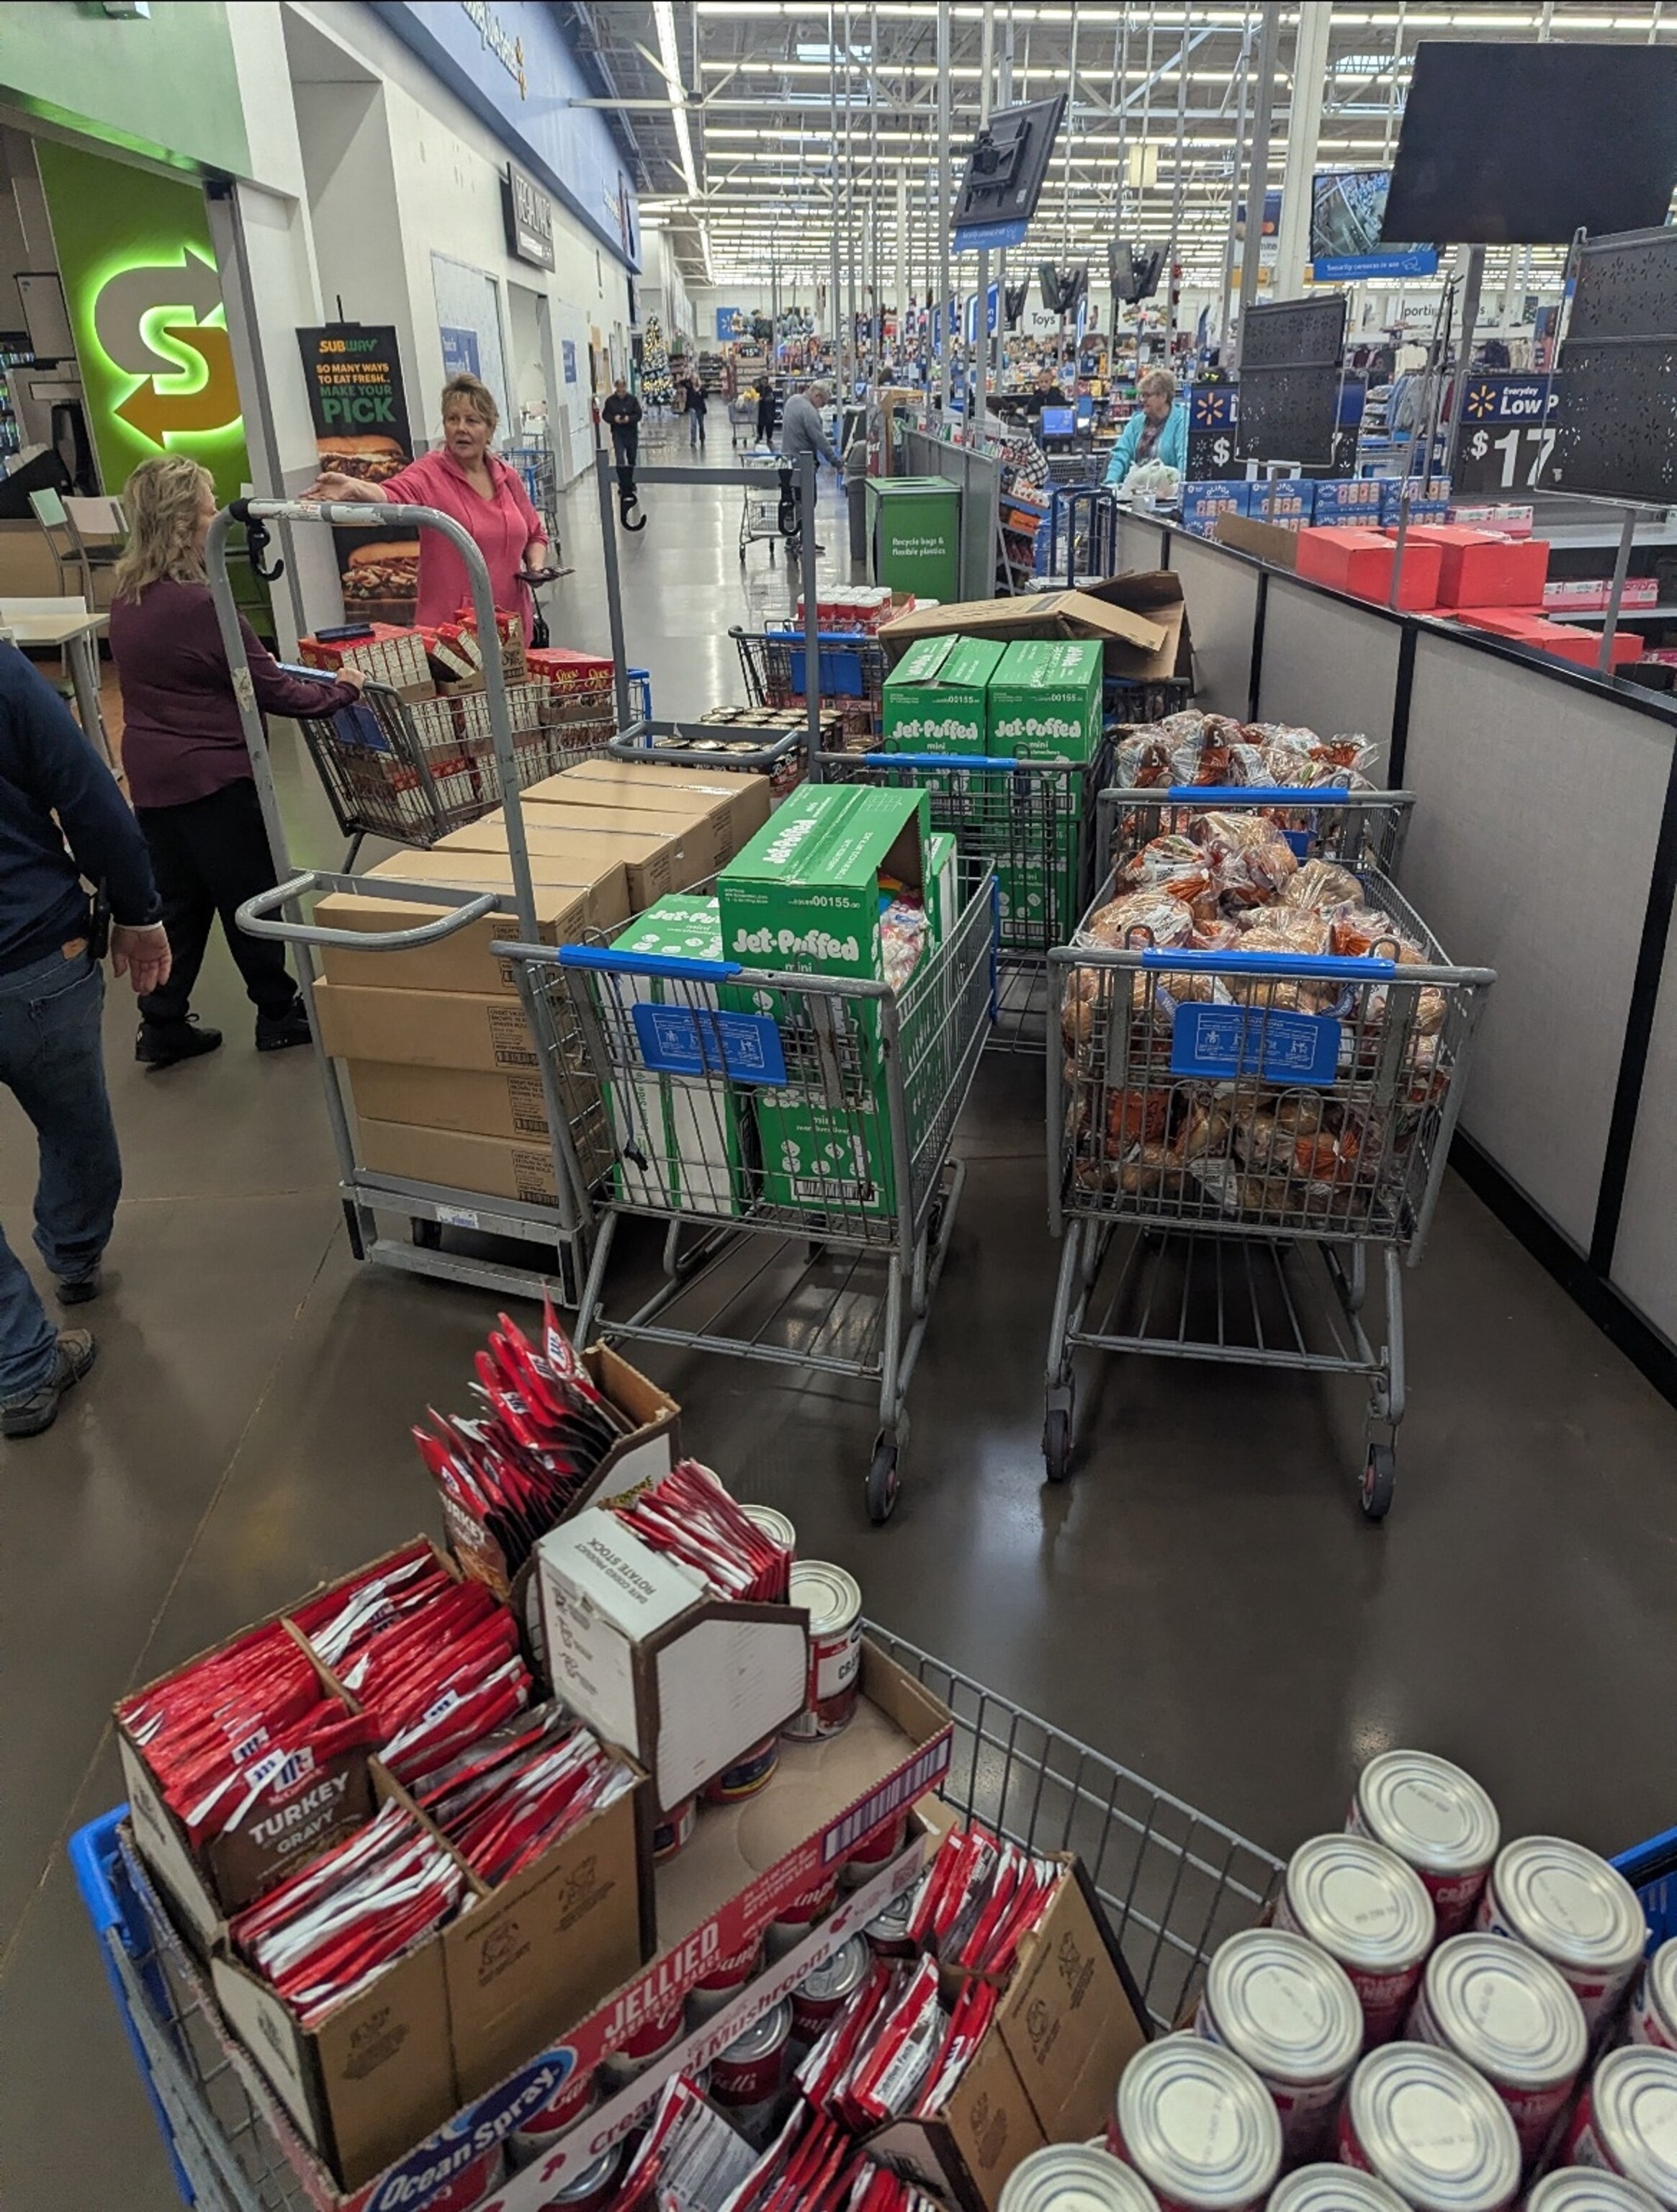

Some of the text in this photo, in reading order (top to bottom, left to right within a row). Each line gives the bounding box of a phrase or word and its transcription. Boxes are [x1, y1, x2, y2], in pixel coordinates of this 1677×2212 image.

[1032, 313, 1056, 328] Toys
[319, 339, 377, 353] SUBWAY
[316, 363, 390, 373] SO MANY WAYS
[318, 375, 332, 384] TO
[333, 374, 351, 383] EAT
[320, 385, 392, 396] MAKE YOUR
[1503, 386, 1539, 397] Everyday
[322, 397, 396, 423] PICK
[1500, 395, 1543, 415] Low
[892, 537, 920, 547] Recycle
[920, 537, 938, 547] bags
[920, 547, 946, 557] plastics
[892, 719, 979, 740] Jet-Puffed
[994, 718, 1081, 738] Jet-Puffed
[762, 819, 819, 865] Jet-Puffed
[647, 909, 721, 924] Jet-Pu
[732, 927, 860, 961] Jet-Puffed
[574, 1543, 649, 1605] DATE CODED PRODUCT
[588, 1538, 656, 1596] ROTATE STOCK
[249, 1771, 349, 1845] TURKEY
[276, 1809, 333, 1854] GRAVY
[604, 1921, 720, 2040] JELLIED
[709, 1941, 832, 2060] Mushroom
[380, 2139, 472, 2211] Ocean
